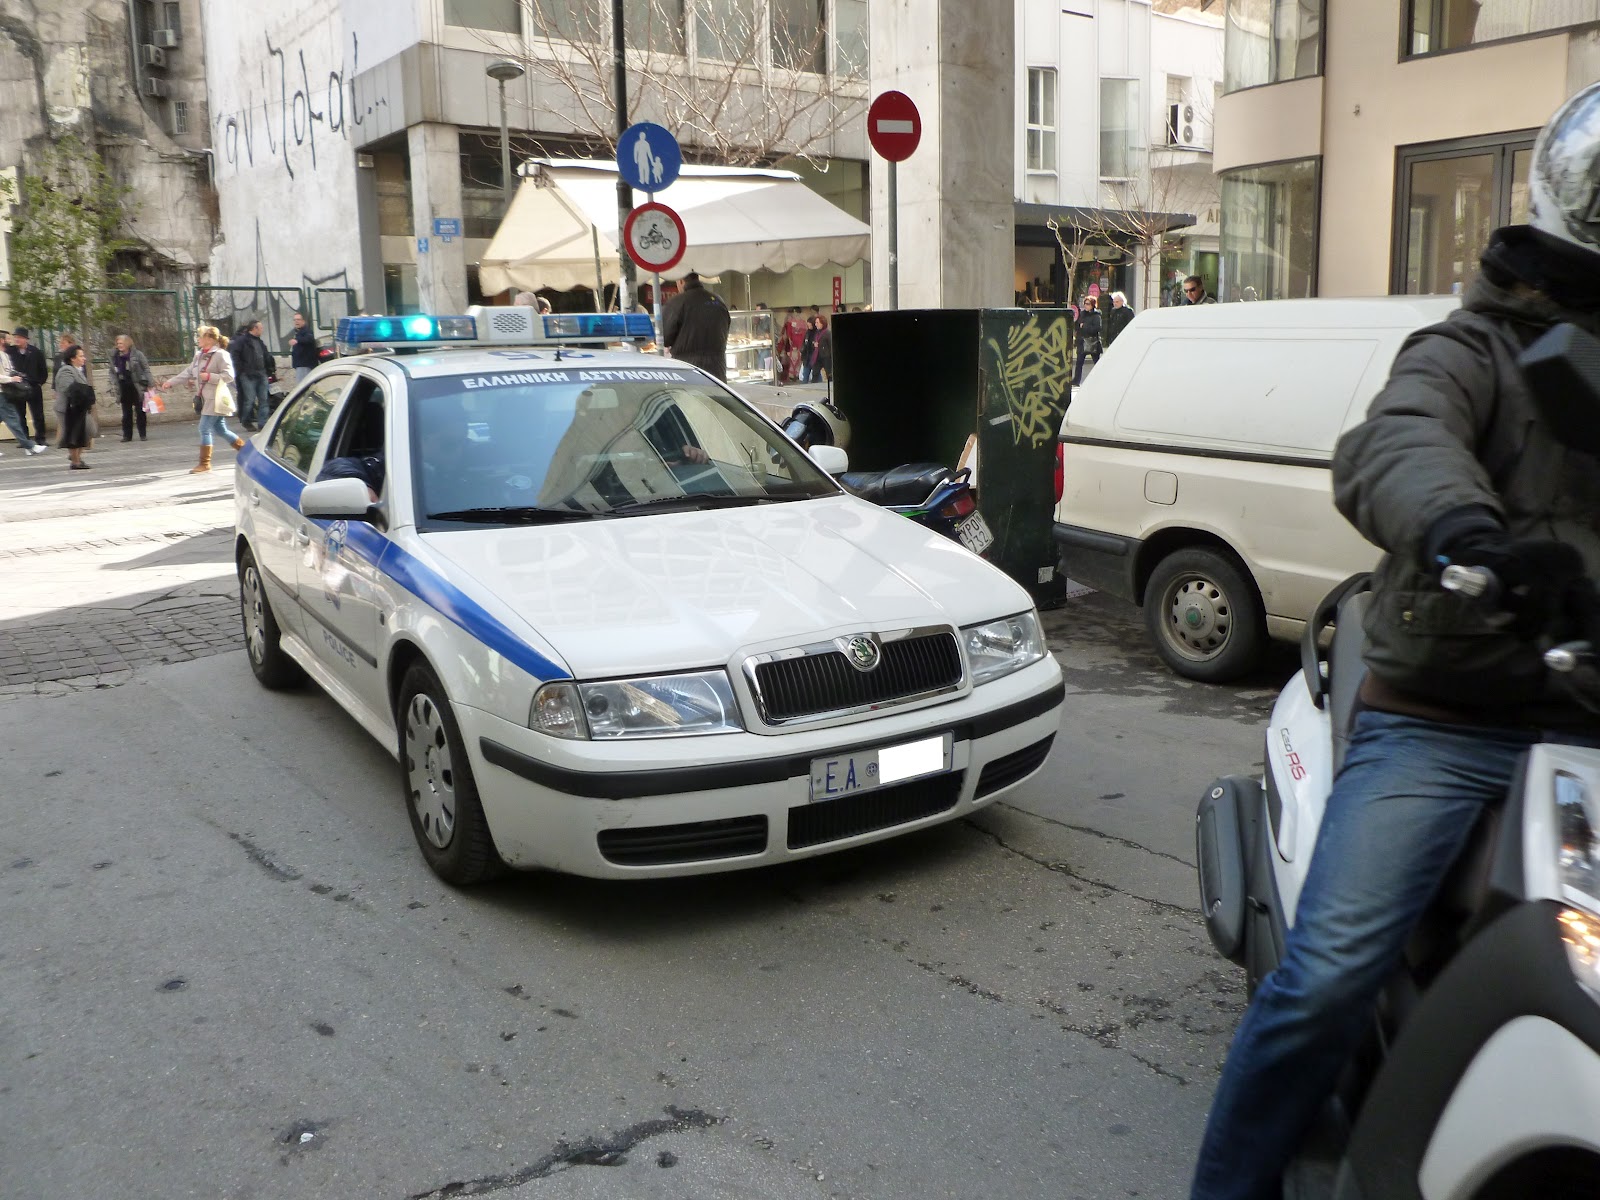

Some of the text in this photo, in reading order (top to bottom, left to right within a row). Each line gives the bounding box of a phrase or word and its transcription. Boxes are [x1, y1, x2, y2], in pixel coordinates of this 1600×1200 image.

[462, 370, 686, 389] ΕΛΛΗΝΙΚΗ ΑΣΤΥΝΟΜΙΑ
[968, 531, 989, 553] 732
[322, 629, 357, 669] POLICE
